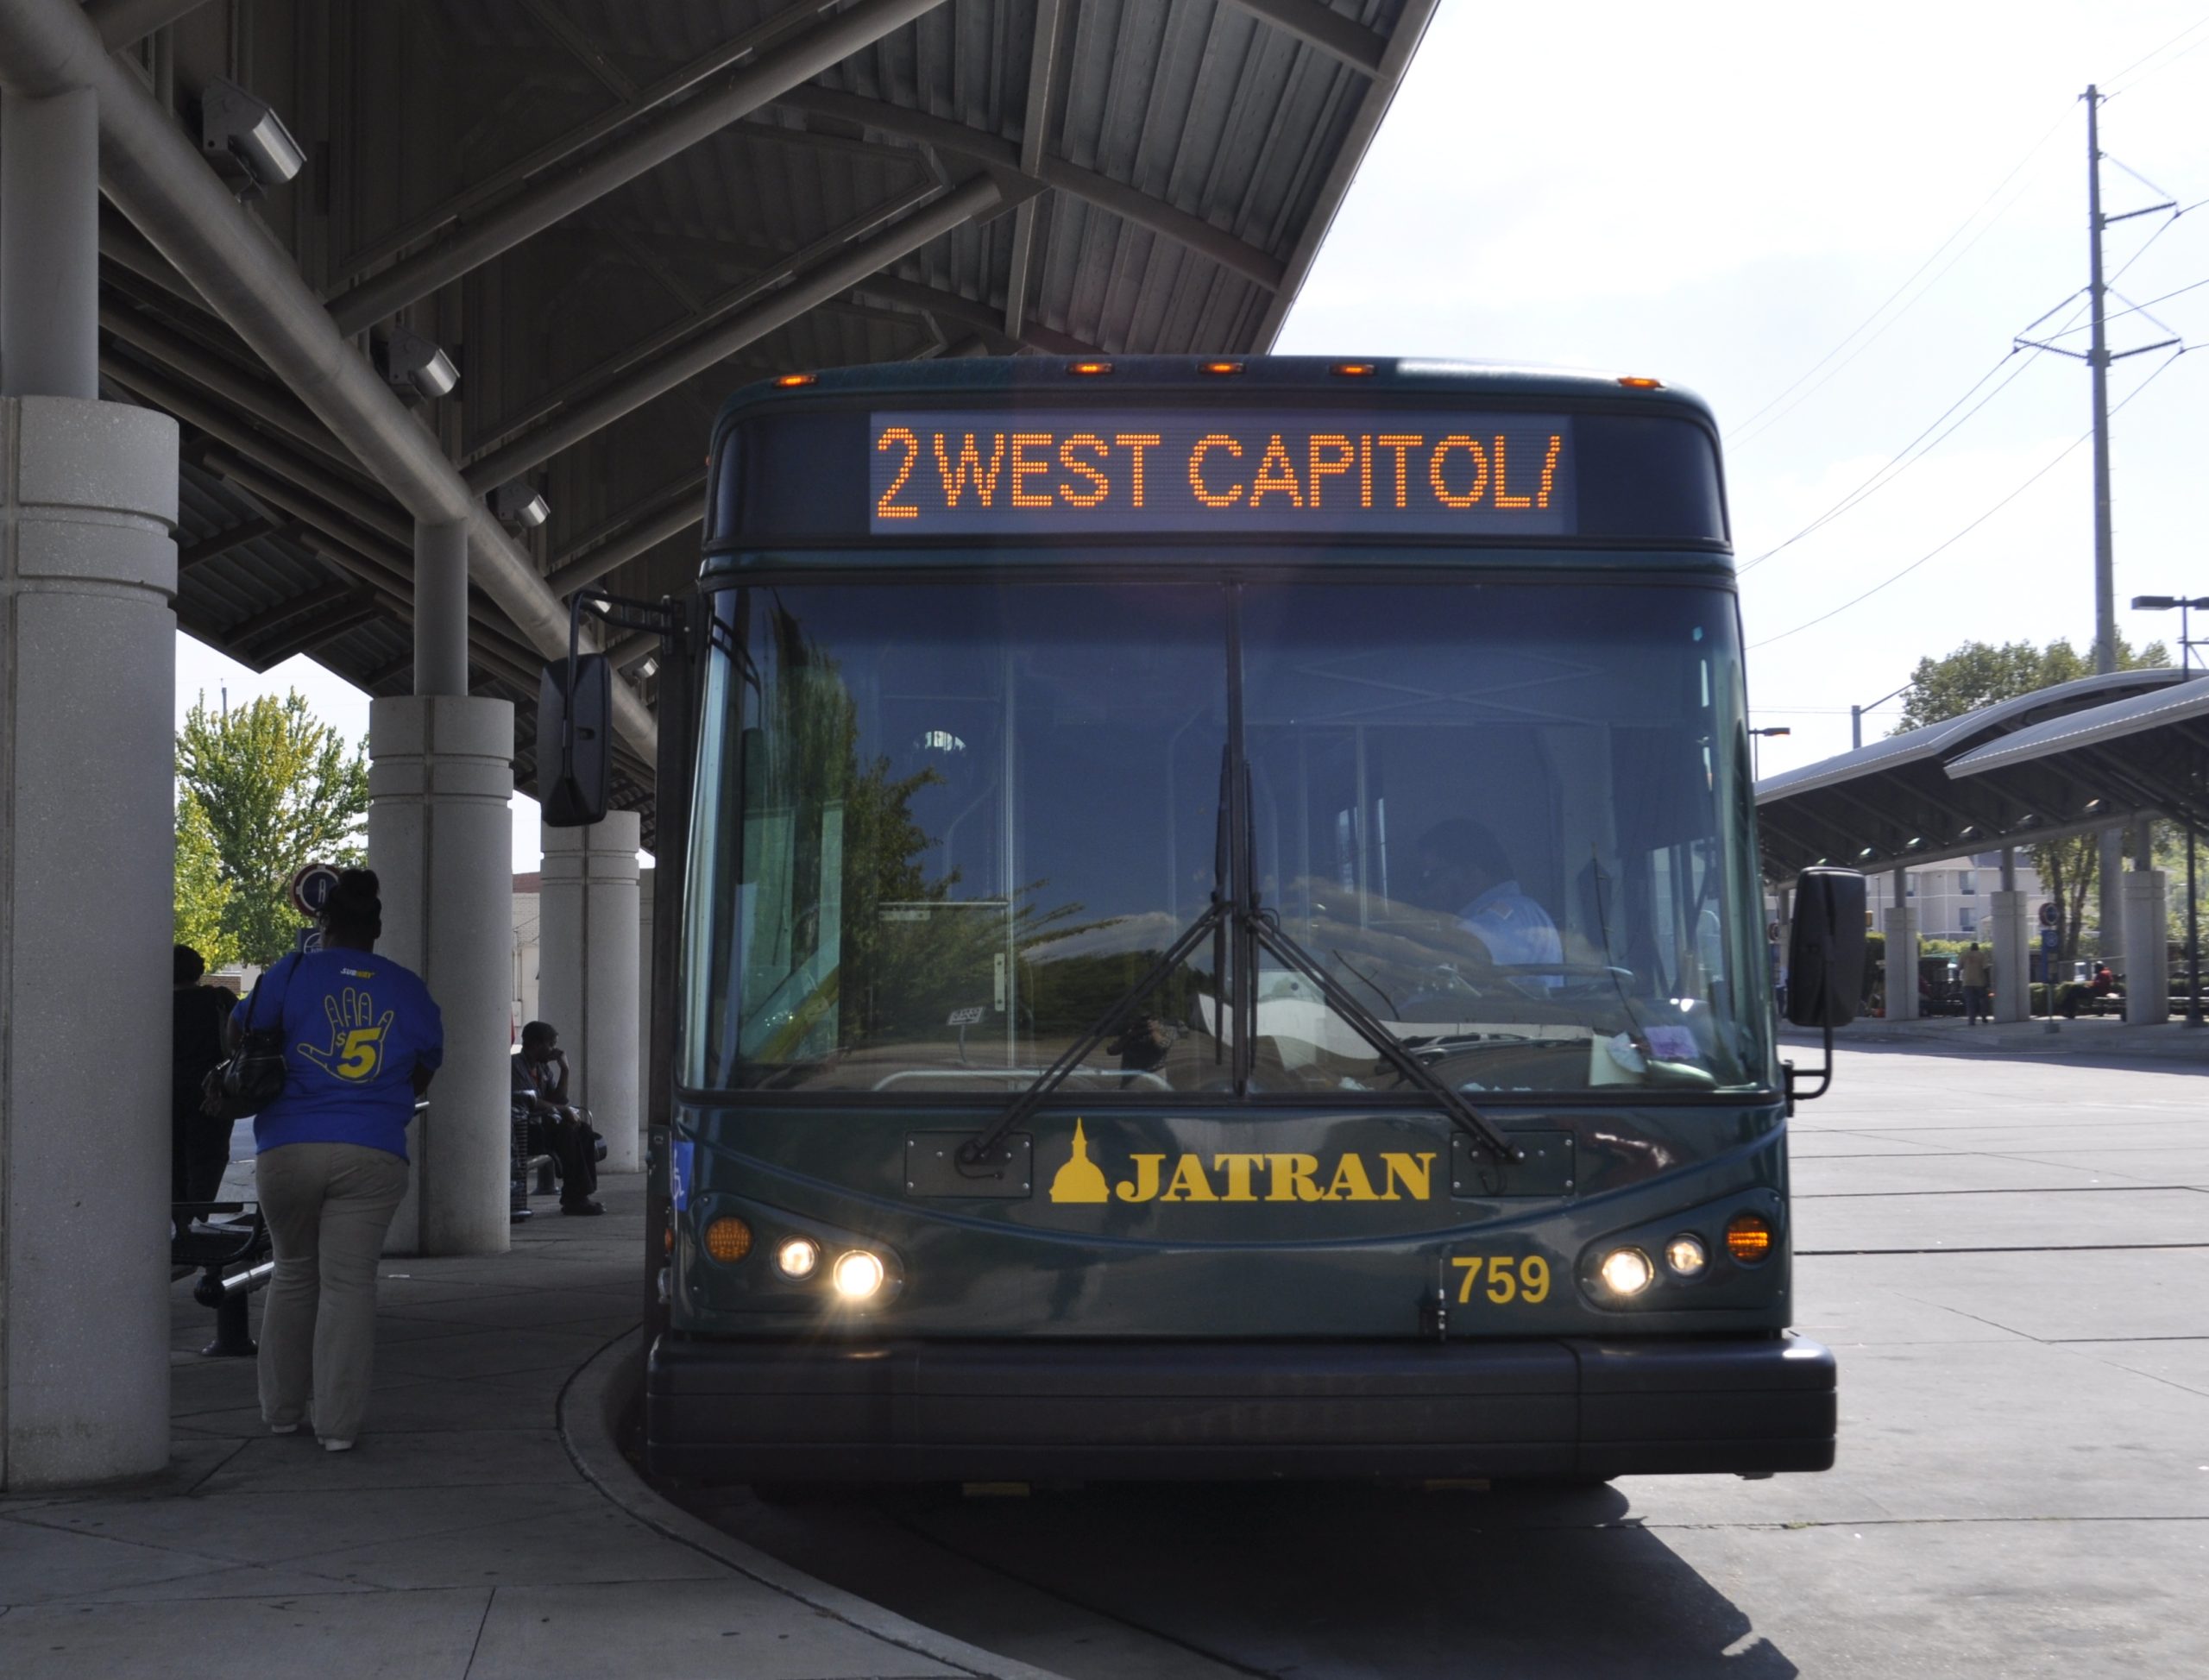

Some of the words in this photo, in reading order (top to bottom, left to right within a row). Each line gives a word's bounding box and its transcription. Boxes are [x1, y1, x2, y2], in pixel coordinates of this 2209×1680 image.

[877, 427, 919, 518] 2
[933, 432, 1161, 507] WEST
[1115, 1152, 1437, 1204] JATRAN
[1451, 1255, 1551, 1304] 759
